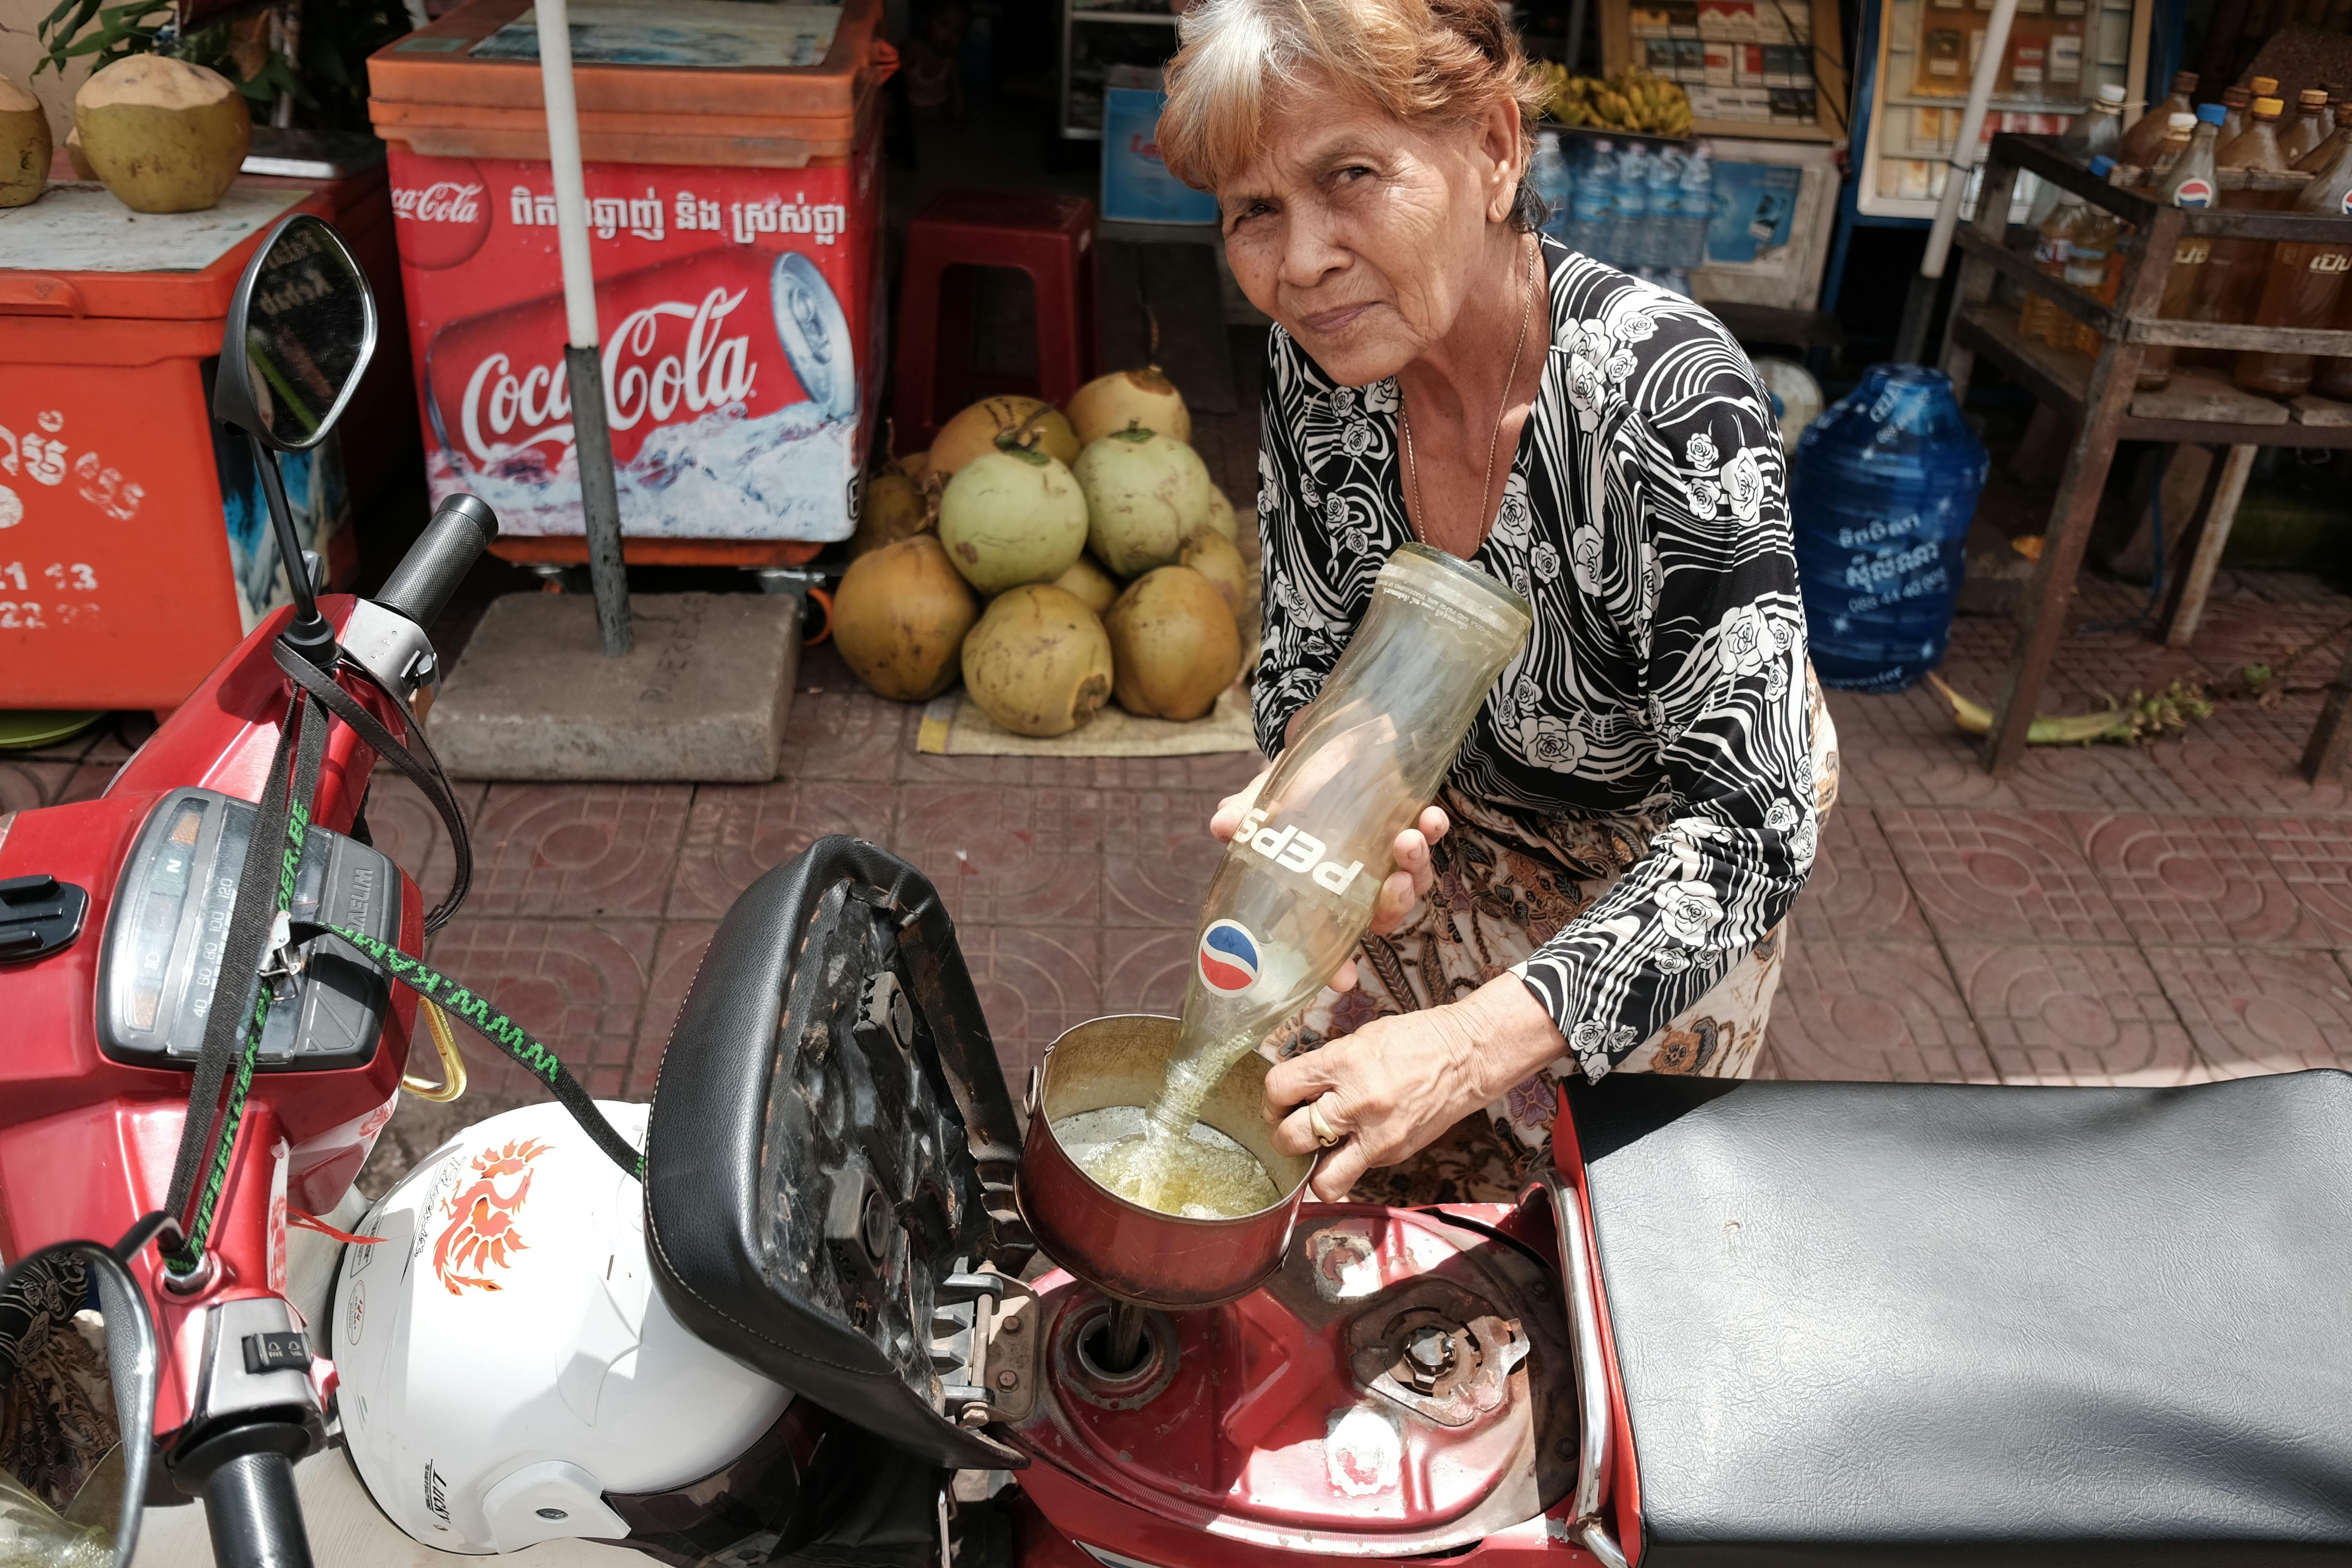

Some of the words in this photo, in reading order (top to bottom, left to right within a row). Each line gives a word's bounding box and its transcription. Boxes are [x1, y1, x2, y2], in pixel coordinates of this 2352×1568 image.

[461, 287, 756, 462] CocaCola
[1233, 808, 1364, 896] PEPS
[166, 859, 182, 873] N
[218, 878, 233, 898] 120
[208, 912, 224, 932] 100
[203, 942, 217, 960] 80
[197, 968, 211, 986] 60
[193, 999, 208, 1017] 40
